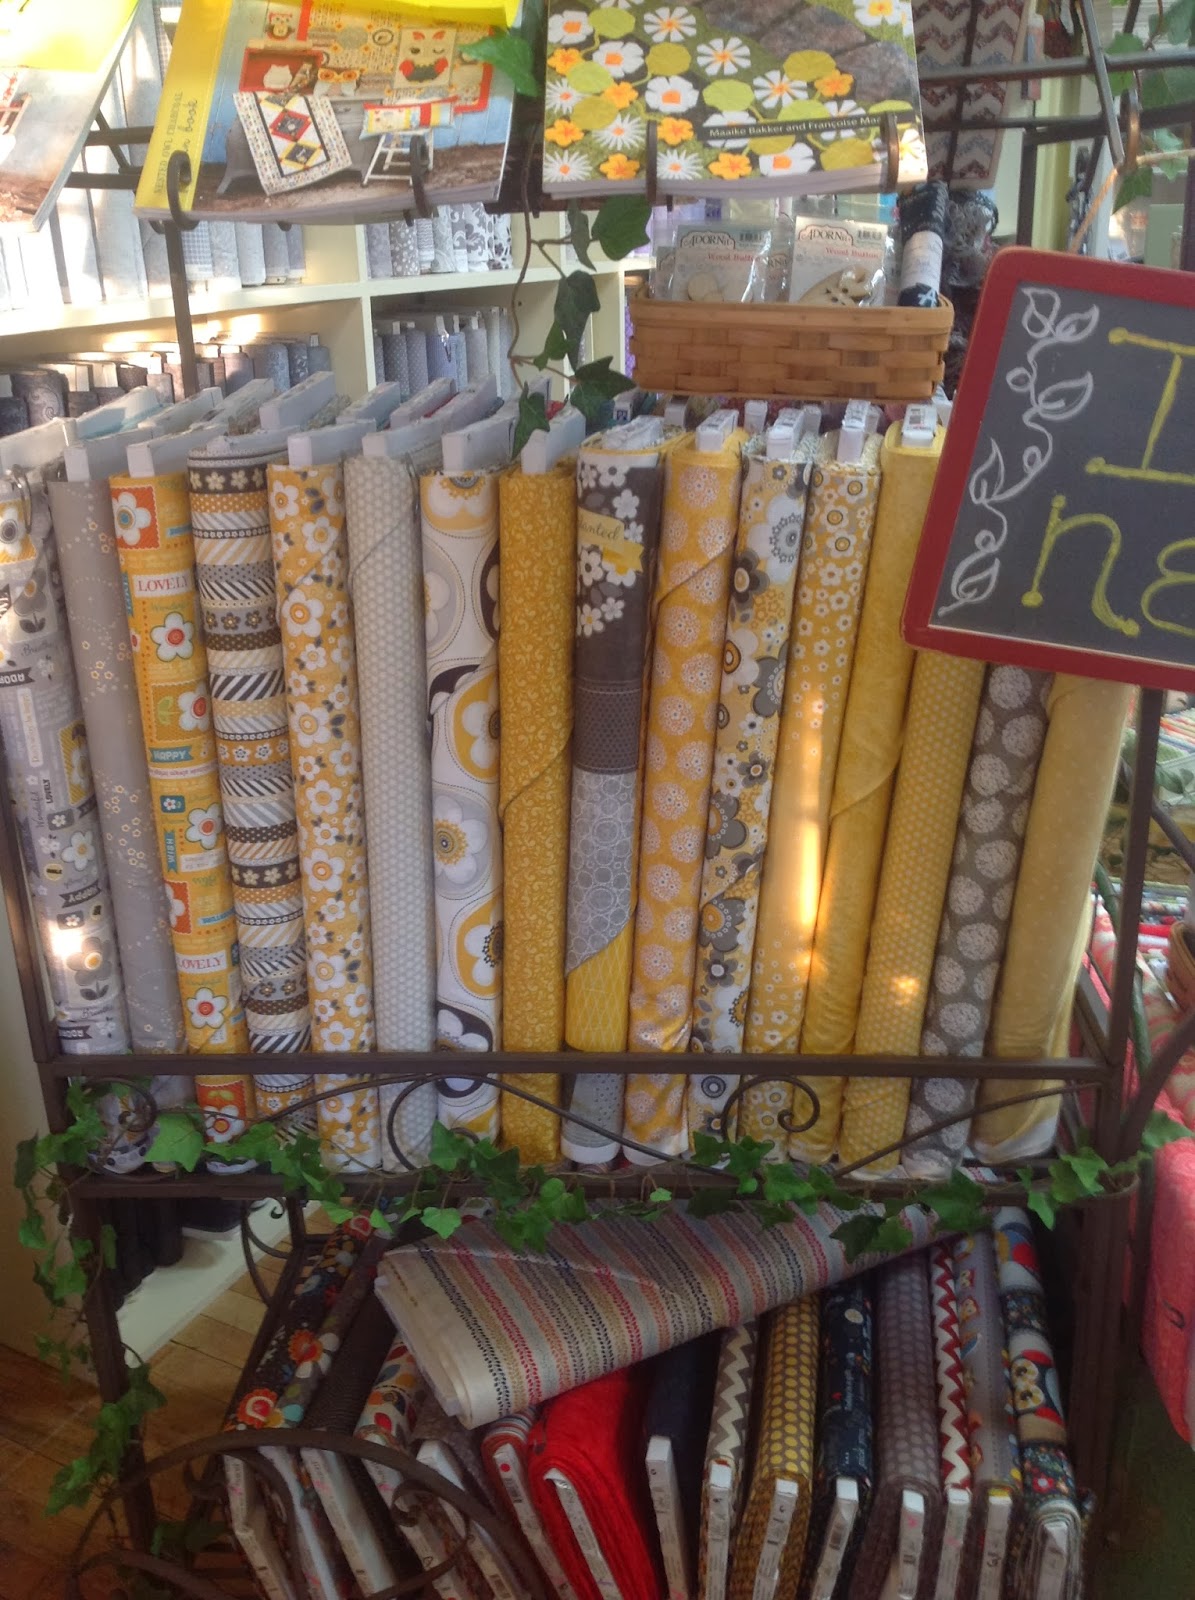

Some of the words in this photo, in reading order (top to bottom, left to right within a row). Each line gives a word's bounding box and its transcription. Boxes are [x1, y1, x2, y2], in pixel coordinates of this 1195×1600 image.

[709, 126, 747, 138] Maaike
[749, 123, 785, 135] Bakker
[785, 121, 806, 132] and
[808, 117, 858, 132] Françoise
[153, 749, 187, 762] HAPPY
